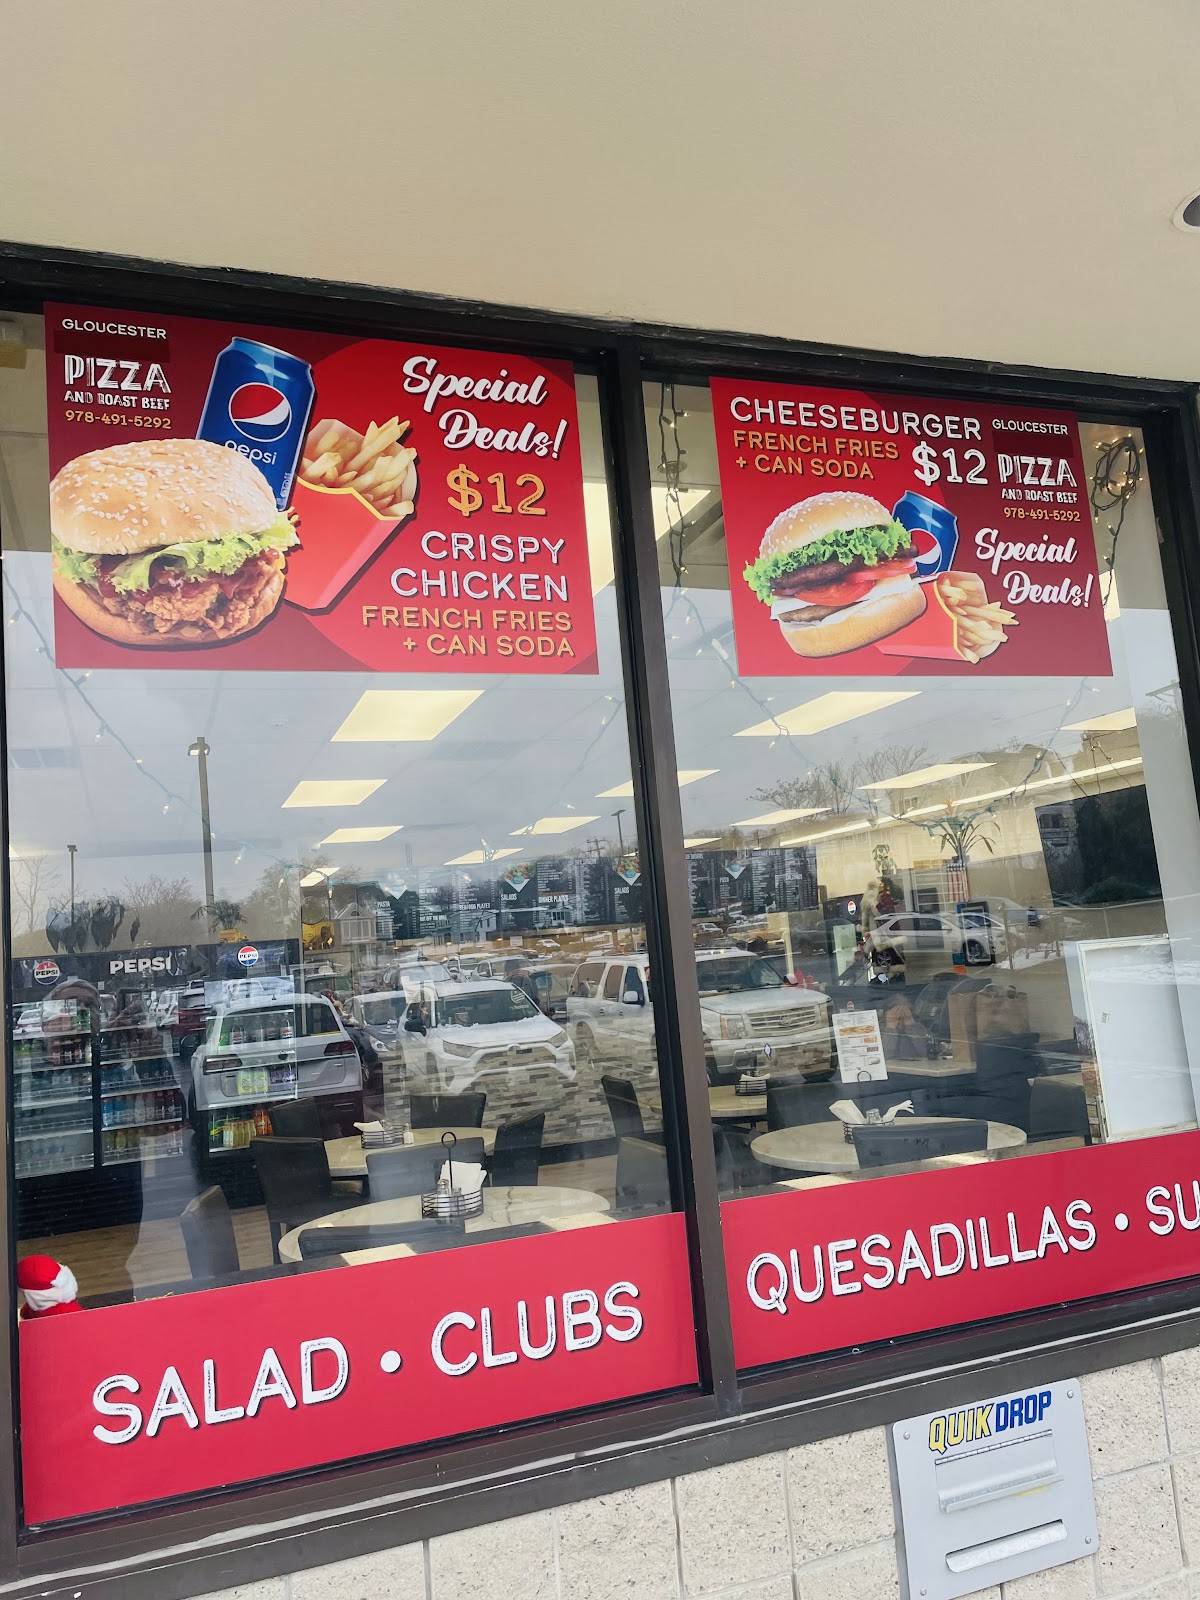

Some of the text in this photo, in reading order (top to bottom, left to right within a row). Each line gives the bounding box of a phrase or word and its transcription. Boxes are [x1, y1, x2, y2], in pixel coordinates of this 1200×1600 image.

[61, 318, 167, 340] GLOUCESTER
[64, 354, 172, 394] PIZZA
[402, 355, 549, 414] Special
[64, 390, 170, 411] AND ROAST BEEF
[65, 409, 172, 430] 978-491-5292
[438, 408, 568, 460] Deals!
[730, 396, 982, 441] CHEESEBURGER
[992, 418, 1069, 436] GLOUCESTER
[733, 429, 899, 460] FRENCH FRIES
[754, 453, 804, 475] CAN
[810, 457, 875, 480] SODA
[912, 441, 989, 487] $12
[997, 453, 1078, 488] PIZZA
[446, 463, 547, 517] $12
[1001, 487, 1078, 504] AND ROAST BEEF
[1003, 506, 1081, 523] 978-491-5292
[421, 530, 566, 565] CRISPY
[975, 527, 1078, 576] Special
[390, 567, 569, 602] CHICKEN
[1003, 570, 1094, 608] Deals!
[362, 605, 573, 632] FRENCH FRIES
[426, 633, 487, 656] CAN
[496, 635, 576, 658] SODA
[35, 969, 59, 977] PEPSI
[109, 956, 172, 976] PEPSI
[746, 1200, 1097, 1314] QUESADILLAS
[92, 1281, 643, 1445] SALAD CLUBS
